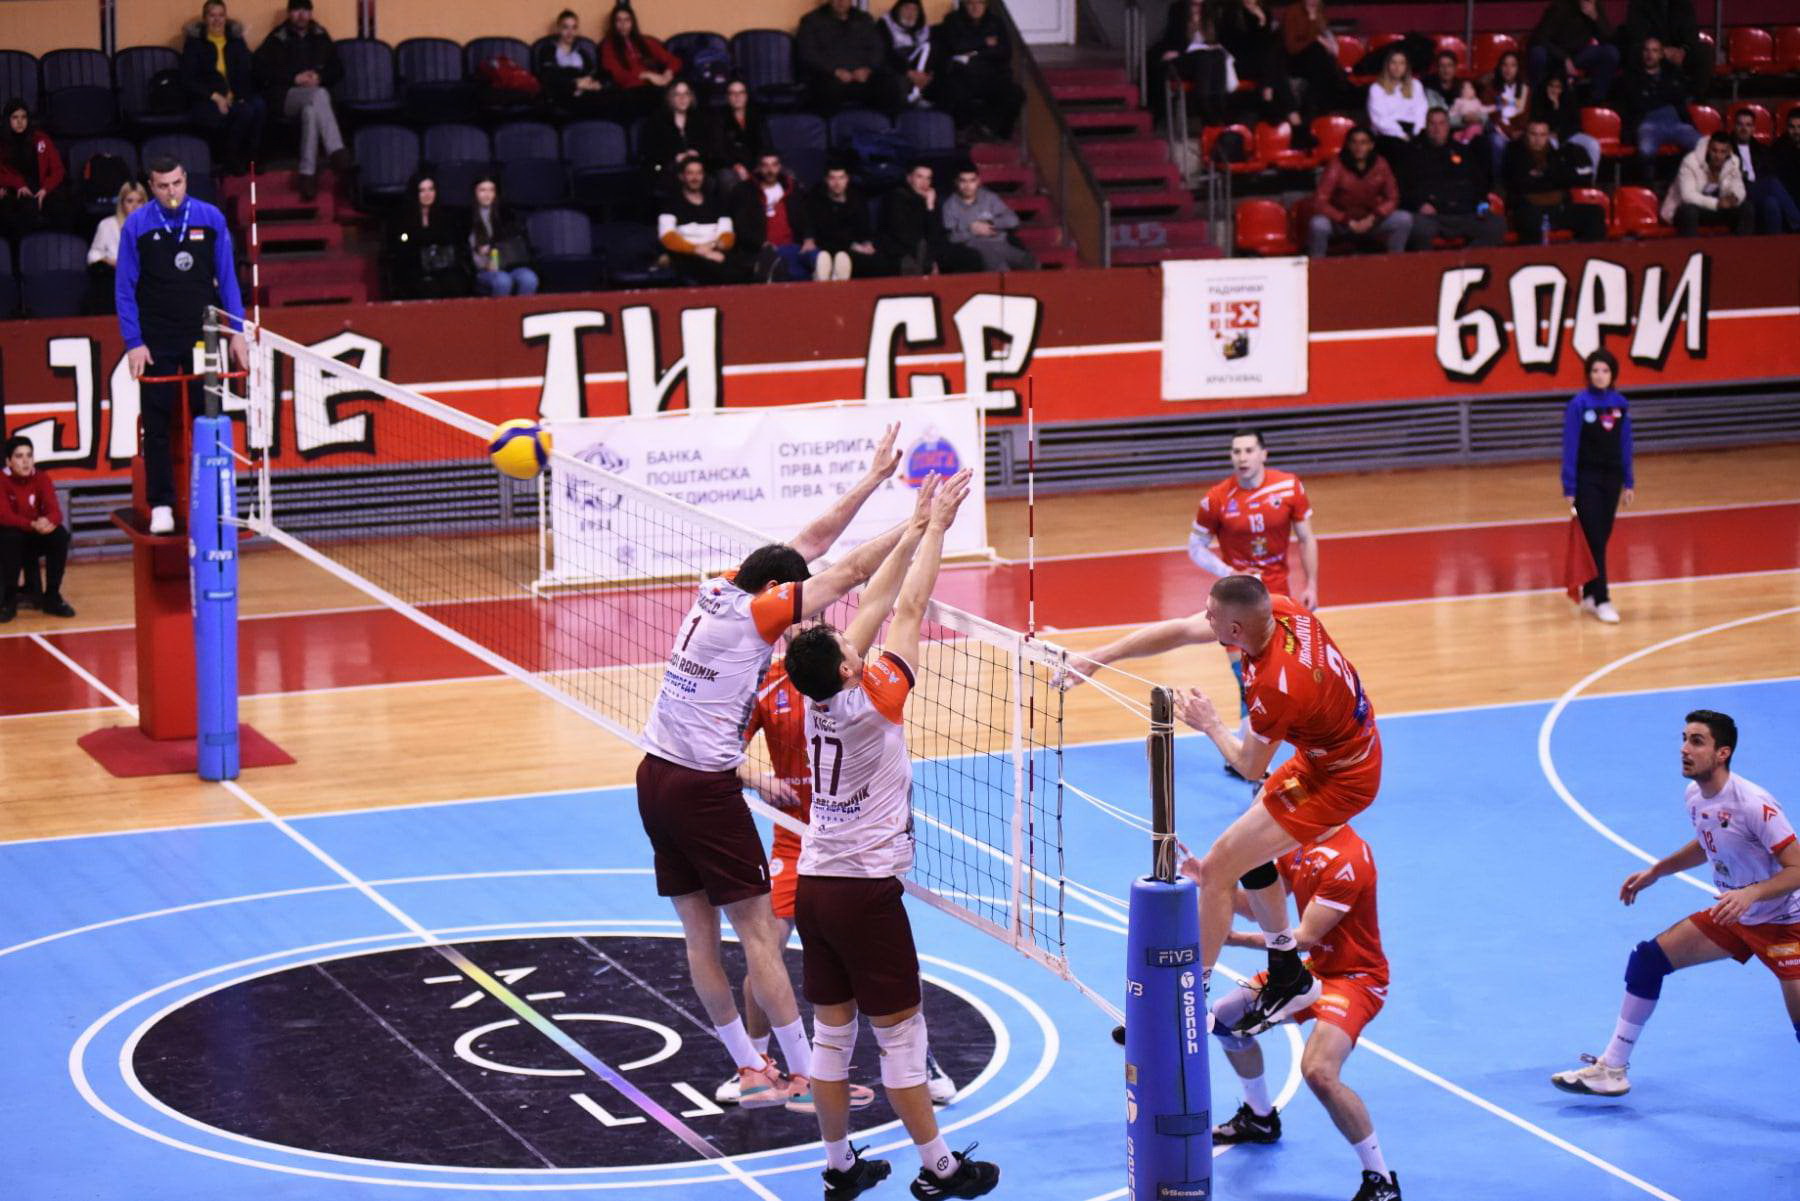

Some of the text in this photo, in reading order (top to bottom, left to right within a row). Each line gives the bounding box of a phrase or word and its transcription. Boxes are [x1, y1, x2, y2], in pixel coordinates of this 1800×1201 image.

[522, 305, 718, 420] ТИ
[854, 293, 1038, 410] СЕ
[1436, 252, 1704, 376] БОРИ
[647, 449, 702, 465] БАНКА
[779, 437, 875, 457] СУПЕРЛИГА
[647, 467, 750, 485] ПОШТАНСКА
[780, 459, 867, 477] ПРВА ЛИГА
[782, 485, 823, 499] ПРВА
[1248, 512, 1264, 533] 13
[681, 614, 702, 653] 1
[811, 733, 843, 797] 17
[1183, 991, 1199, 1054] Senoh
